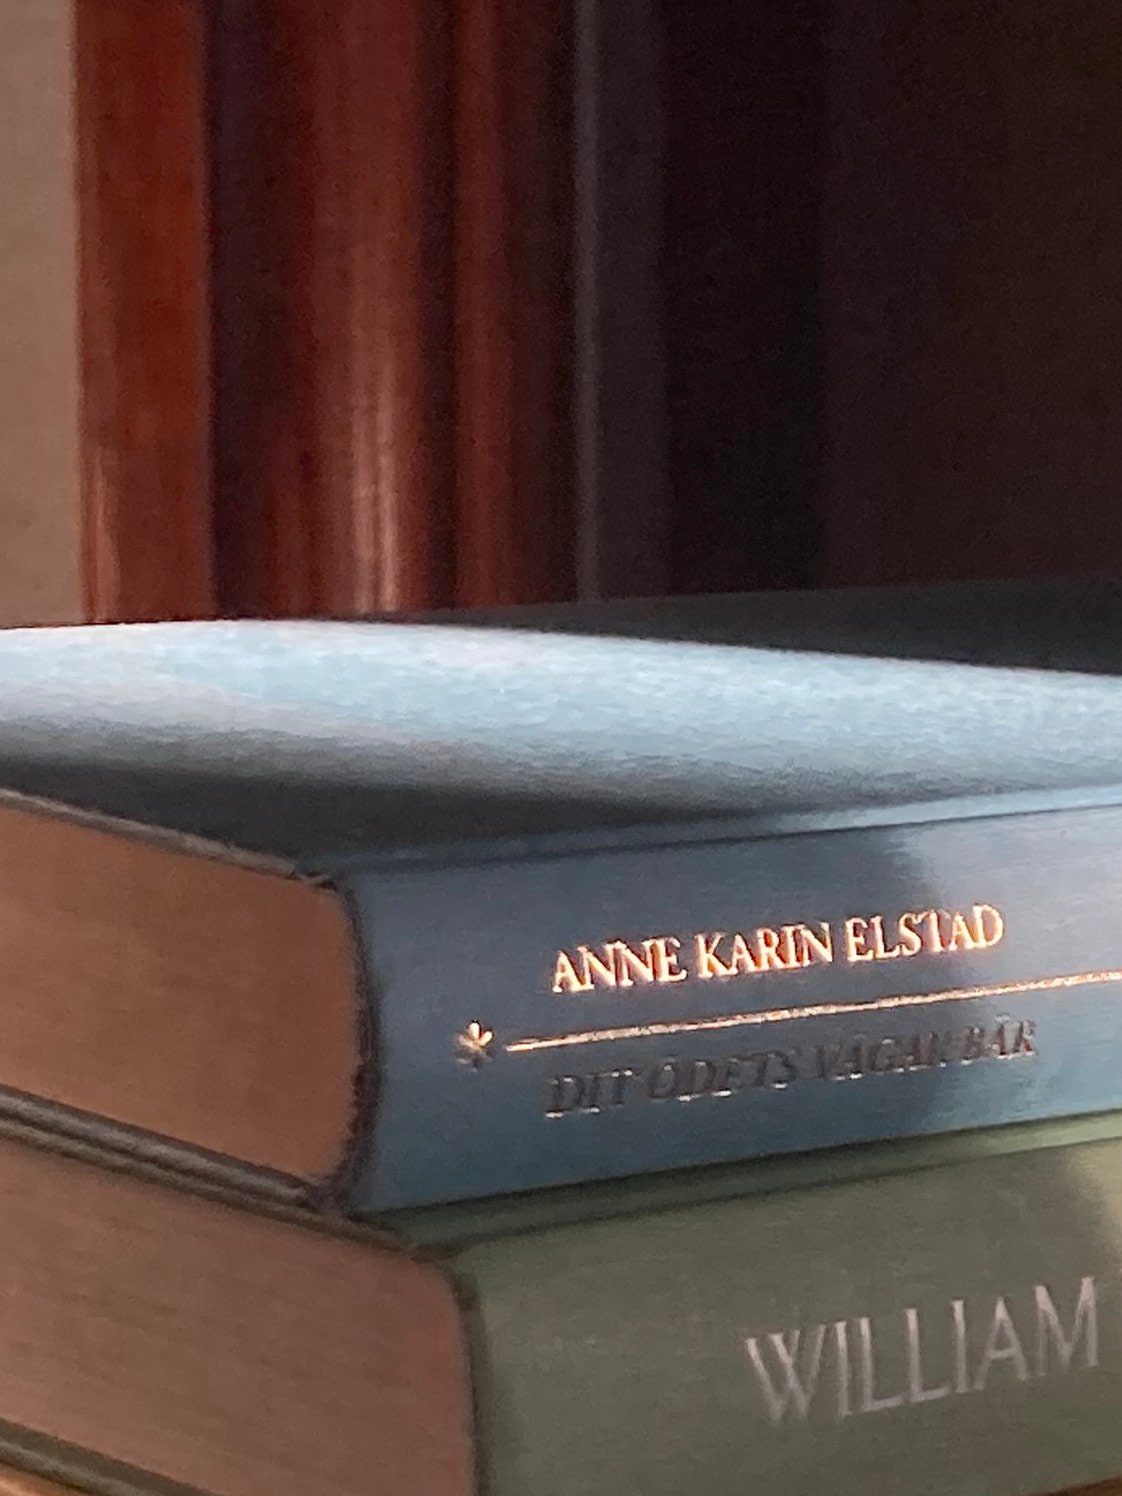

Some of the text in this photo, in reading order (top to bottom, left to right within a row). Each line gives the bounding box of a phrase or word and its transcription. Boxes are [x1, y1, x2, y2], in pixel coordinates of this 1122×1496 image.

[550, 903, 1004, 994] ANNE KARIN ELSTAD
[743, 1276, 1100, 1424] WILLIAM
